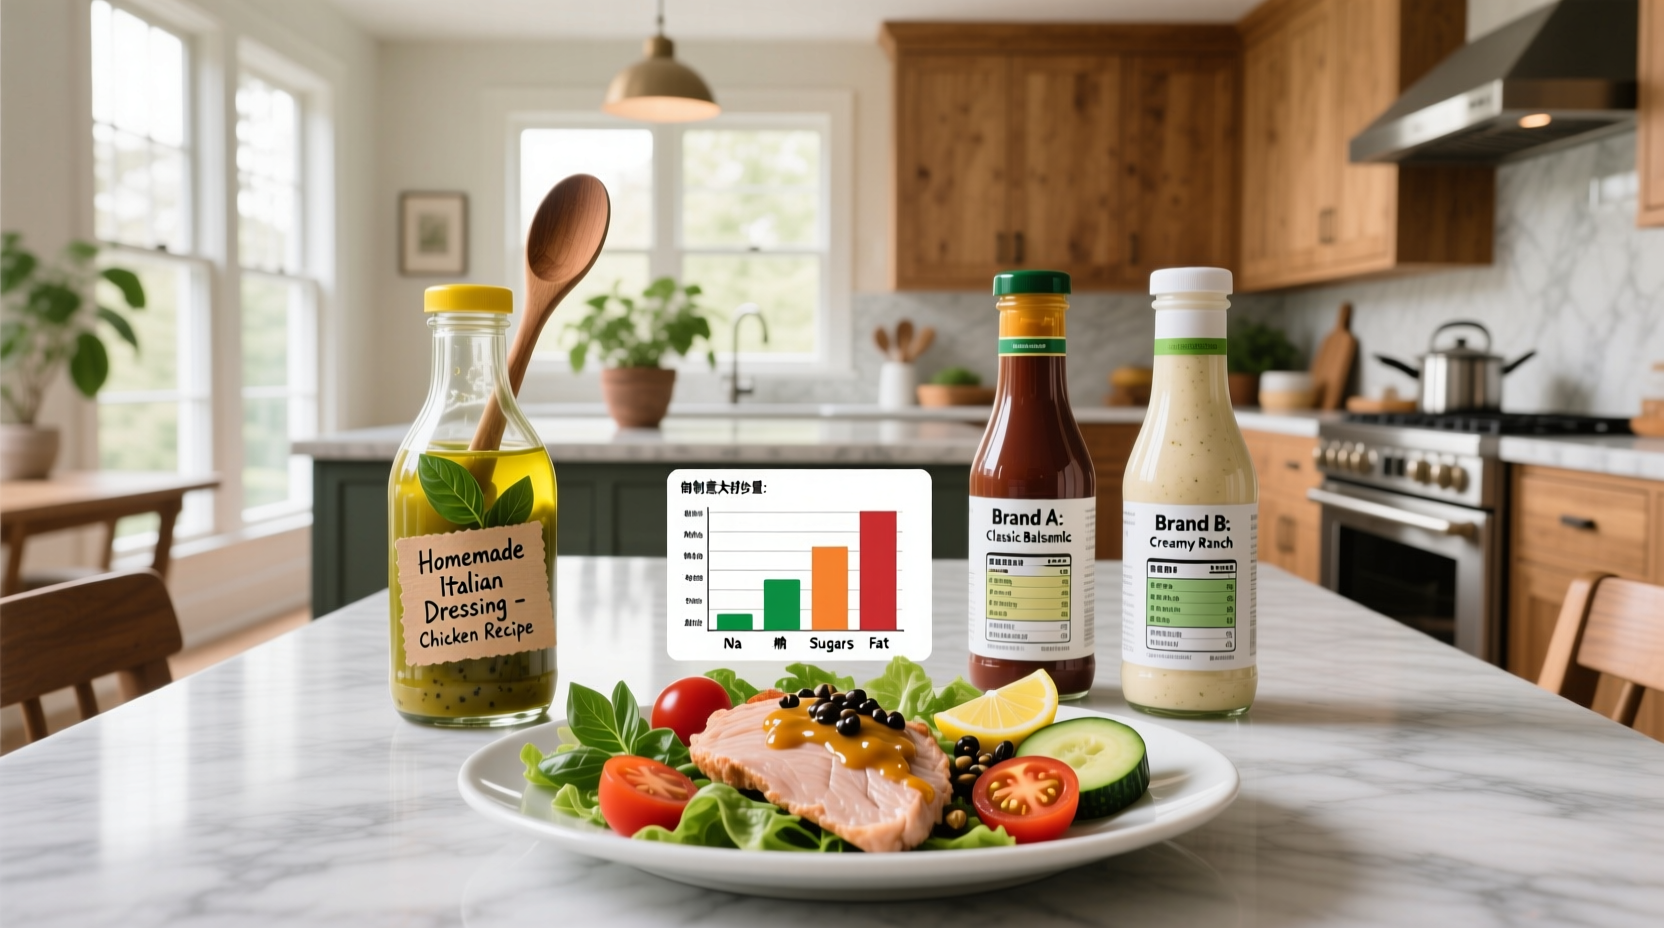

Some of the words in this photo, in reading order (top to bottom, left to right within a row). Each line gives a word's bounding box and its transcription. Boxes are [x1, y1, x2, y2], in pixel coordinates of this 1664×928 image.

[992, 508, 1041, 526] Brand
[1046, 508, 1064, 526] A:
[1155, 514, 1209, 532] Brand
[1214, 514, 1231, 532] B:
[418, 537, 525, 575] Homemade
[1149, 536, 1195, 552] Creamy
[1198, 536, 1234, 549] Ranch
[439, 571, 503, 597] Italian
[424, 598, 507, 624] Dressing
[419, 627, 479, 648] Chicken
[484, 621, 534, 642] Recipe
